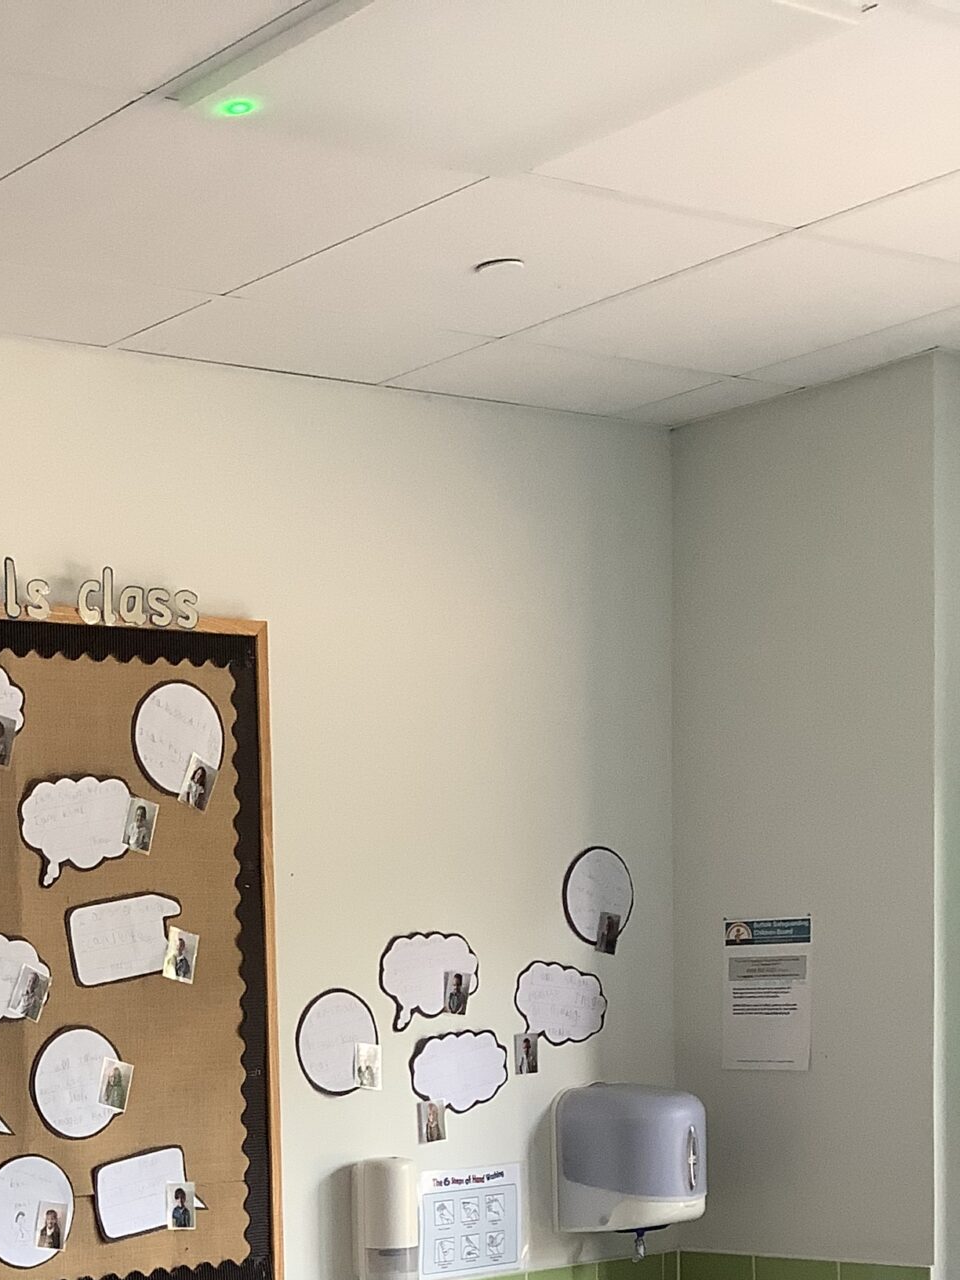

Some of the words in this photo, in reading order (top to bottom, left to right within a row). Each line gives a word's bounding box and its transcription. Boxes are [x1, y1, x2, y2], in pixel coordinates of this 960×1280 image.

[77, 566, 200, 630] class
[432, 1177, 443, 1187] The
[443, 1177, 450, 1186] 6
